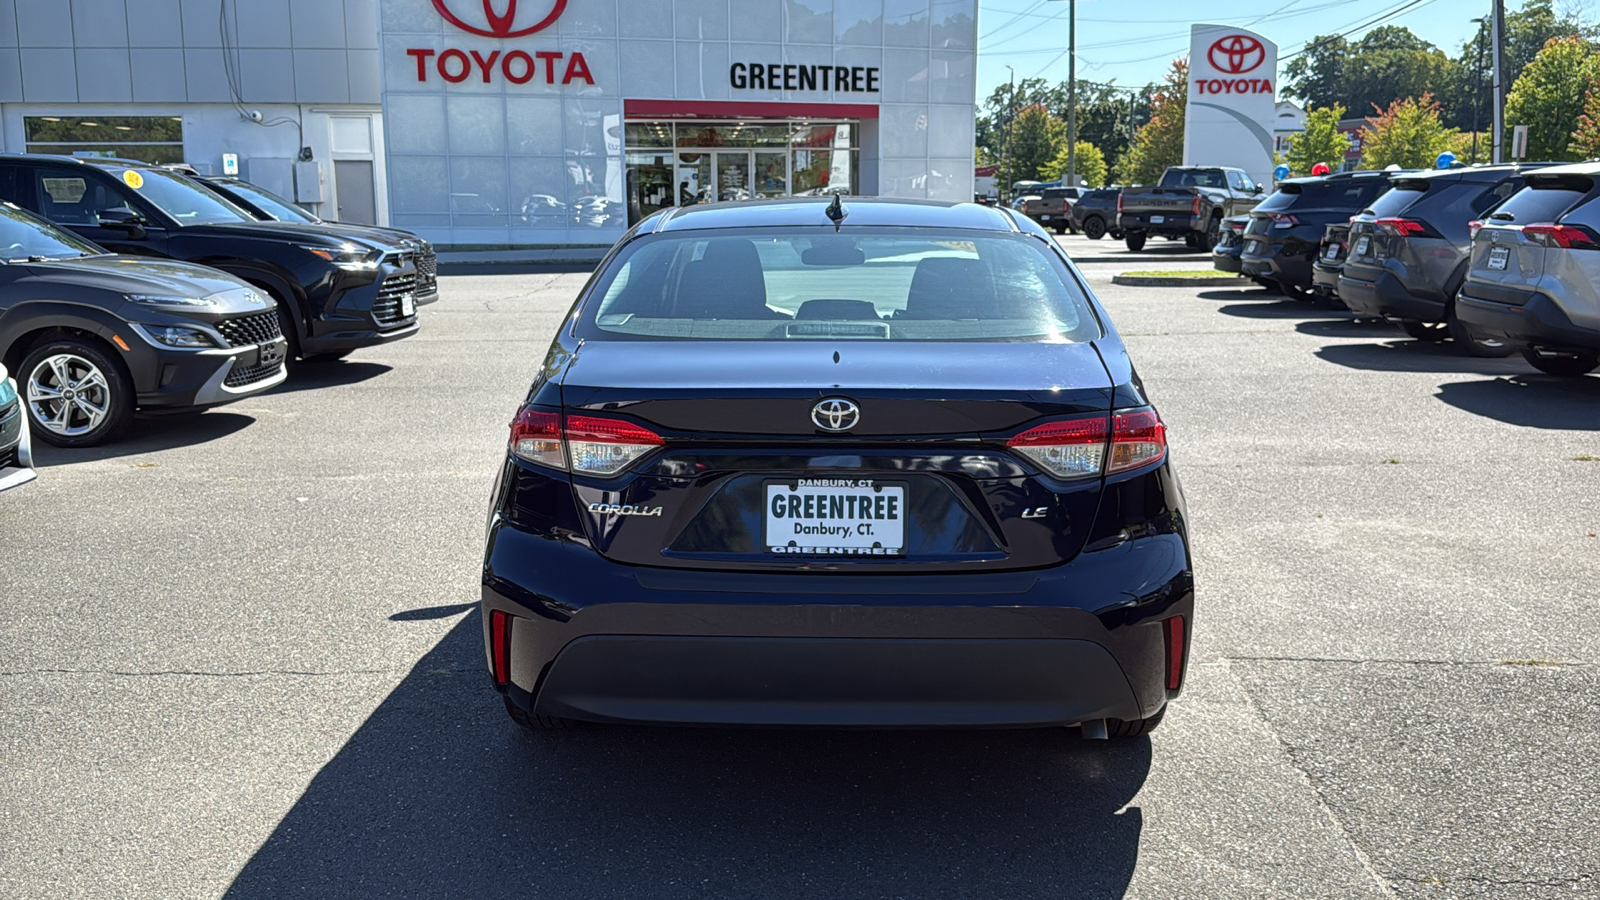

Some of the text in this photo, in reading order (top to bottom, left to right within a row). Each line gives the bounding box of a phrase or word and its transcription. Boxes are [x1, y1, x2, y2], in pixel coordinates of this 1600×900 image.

[406, 48, 596, 85] TOYOTA
[730, 62, 880, 93] GREENTREE
[1195, 79, 1273, 94] TOYOTA
[798, 479, 855, 488] DANBURY,
[588, 502, 663, 517] COROLLA
[771, 494, 898, 520] GREENTREE
[1021, 506, 1049, 519] LE
[794, 522, 875, 539] Danbury, CT.
[771, 546, 899, 555] GREENTREE
